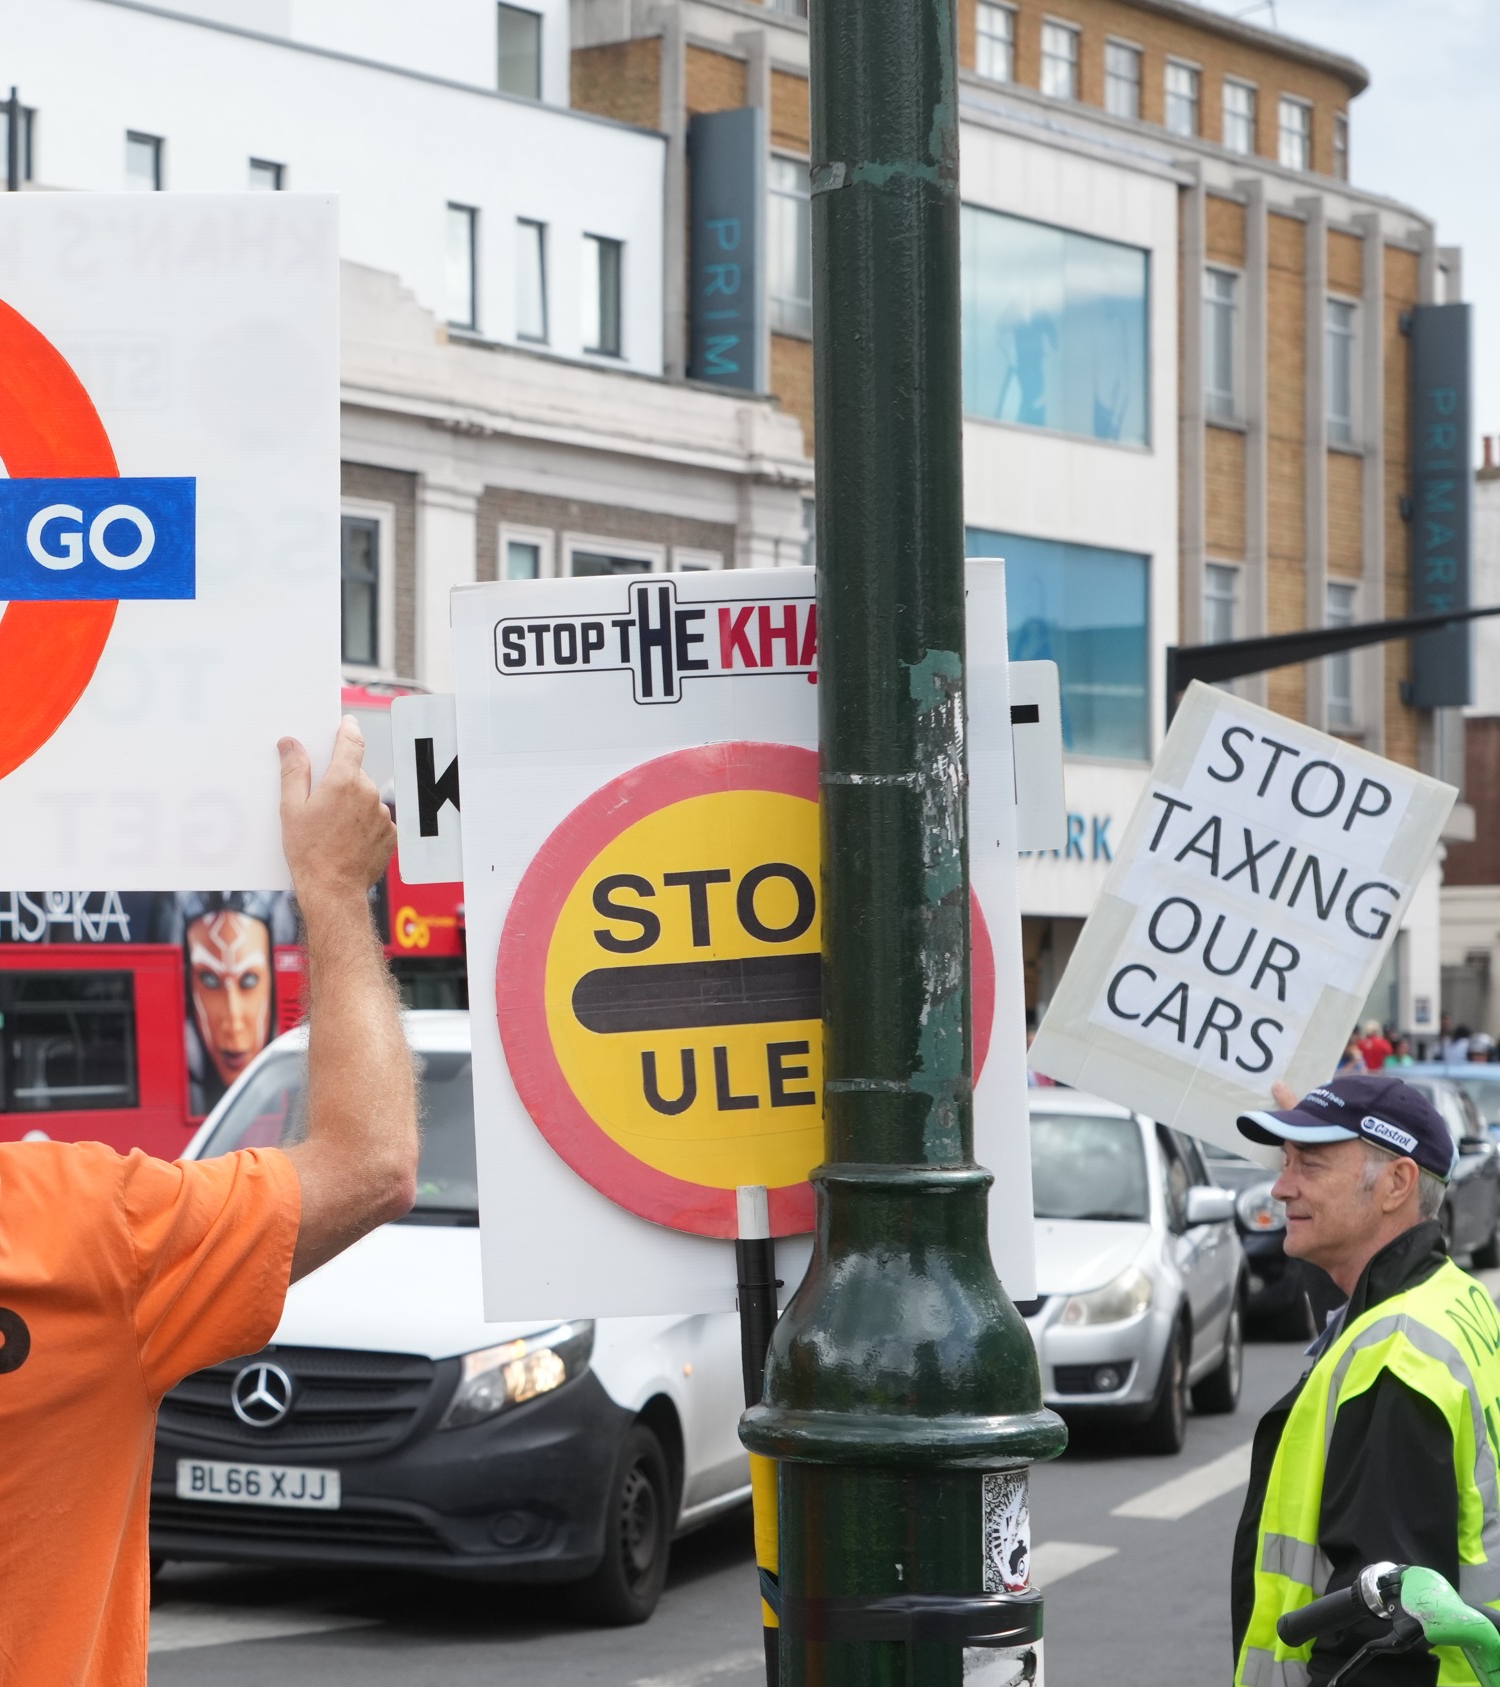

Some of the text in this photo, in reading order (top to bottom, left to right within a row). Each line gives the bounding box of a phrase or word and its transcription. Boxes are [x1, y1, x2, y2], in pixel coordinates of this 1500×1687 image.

[703, 216, 741, 376] PRIM
[26, 503, 156, 571] GO
[501, 620, 606, 668] STOP
[611, 586, 709, 698] THE
[1206, 725, 1393, 832] STOP
[591, 862, 817, 955] STO
[1148, 791, 1401, 941] TAXING
[1147, 896, 1301, 1002] OUR
[1106, 963, 1285, 1074] CARS
[640, 1040, 822, 1116] ULE
[1373, 1122, 1414, 1148] Castrol
[1445, 1285, 1500, 1367] NO
[190, 1464, 326, 1501] BL66 XJJ
